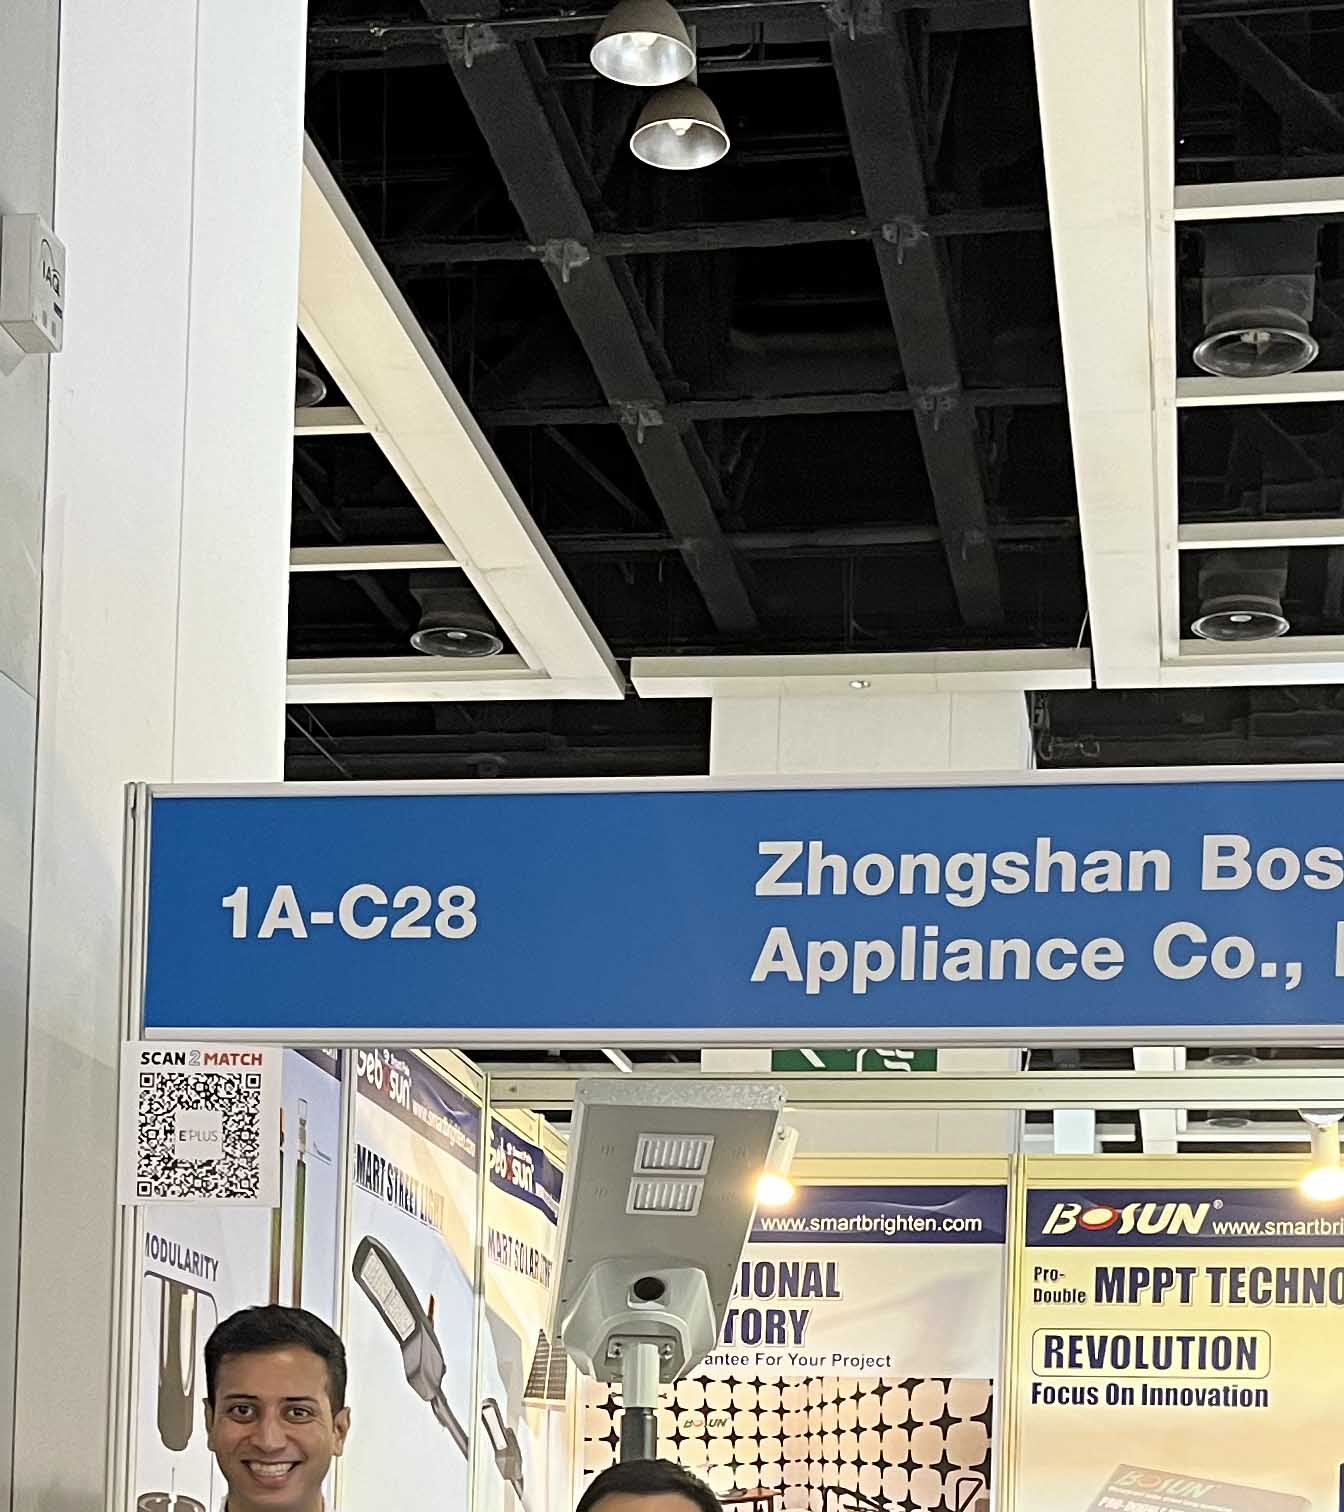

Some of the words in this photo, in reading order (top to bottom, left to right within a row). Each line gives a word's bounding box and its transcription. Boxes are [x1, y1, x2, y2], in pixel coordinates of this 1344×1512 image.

[756, 838, 1170, 907] Zhongshan
[223, 884, 476, 940] 1A-C28
[751, 925, 1124, 994] Appliance
[1154, 922, 1301, 990] Co.,
[140, 1051, 185, 1066] SCAN
[188, 1050, 200, 1066] 2
[204, 1052, 262, 1066] MATCH
[354, 1143, 385, 1195] MART
[760, 1213, 983, 1235] www.smartbrighten.com
[1042, 1201, 1211, 1235] BOSUN
[732, 1261, 840, 1299] IONAL
[1033, 1266, 1066, 1282] Pro-
[1094, 1266, 1197, 1305] MPPT
[1033, 1287, 1087, 1304] Double
[756, 1353, 783, 1366] For
[788, 1353, 826, 1367] Your
[831, 1353, 891, 1369] Project
[1044, 1335, 1257, 1371] REVOLUTION
[1031, 1383, 1098, 1406] Focus
[1105, 1384, 1135, 1406] On
[1142, 1384, 1269, 1408] Innovation
